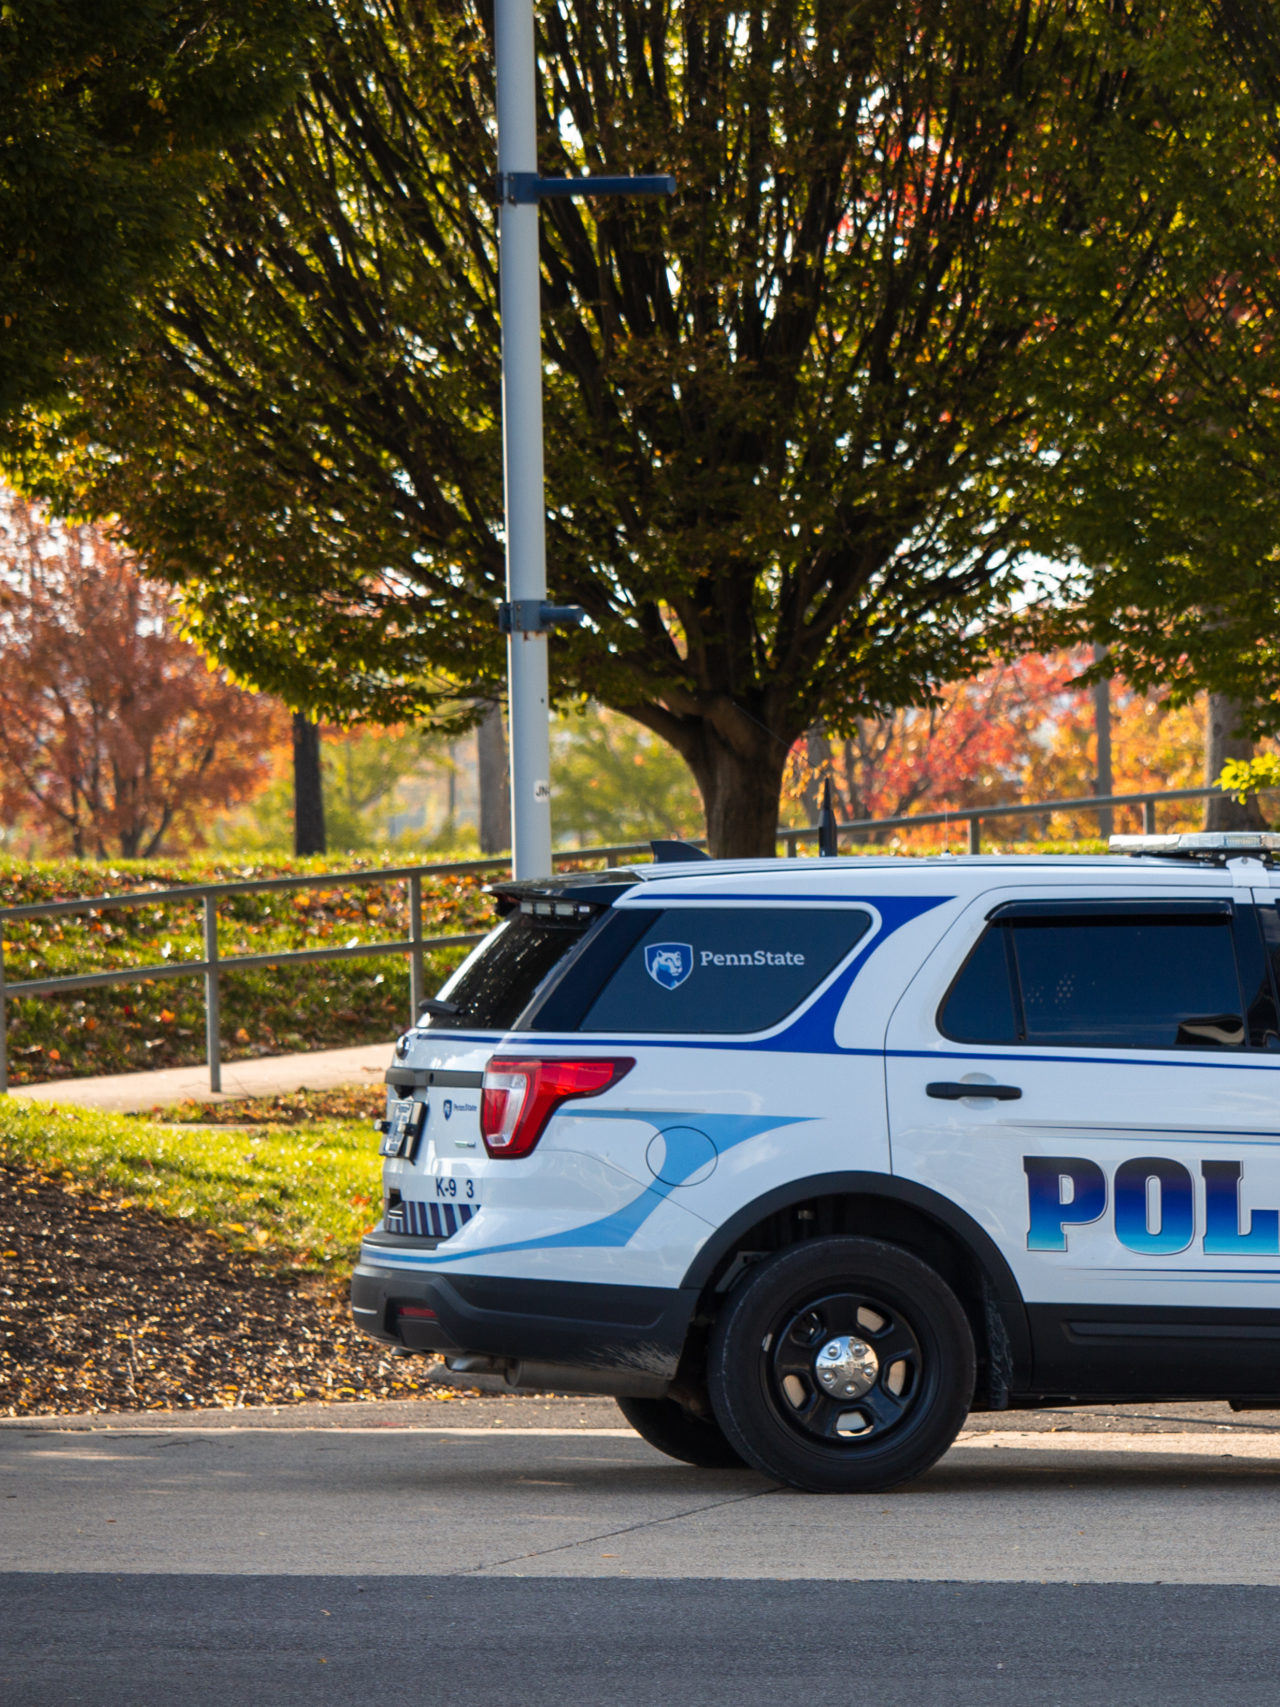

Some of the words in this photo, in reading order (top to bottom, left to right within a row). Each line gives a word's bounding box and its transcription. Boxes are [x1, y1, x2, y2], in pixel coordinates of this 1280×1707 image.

[700, 951, 805, 966] PennState
[435, 1177, 457, 1197] K-9
[466, 1179, 474, 1198] 3
